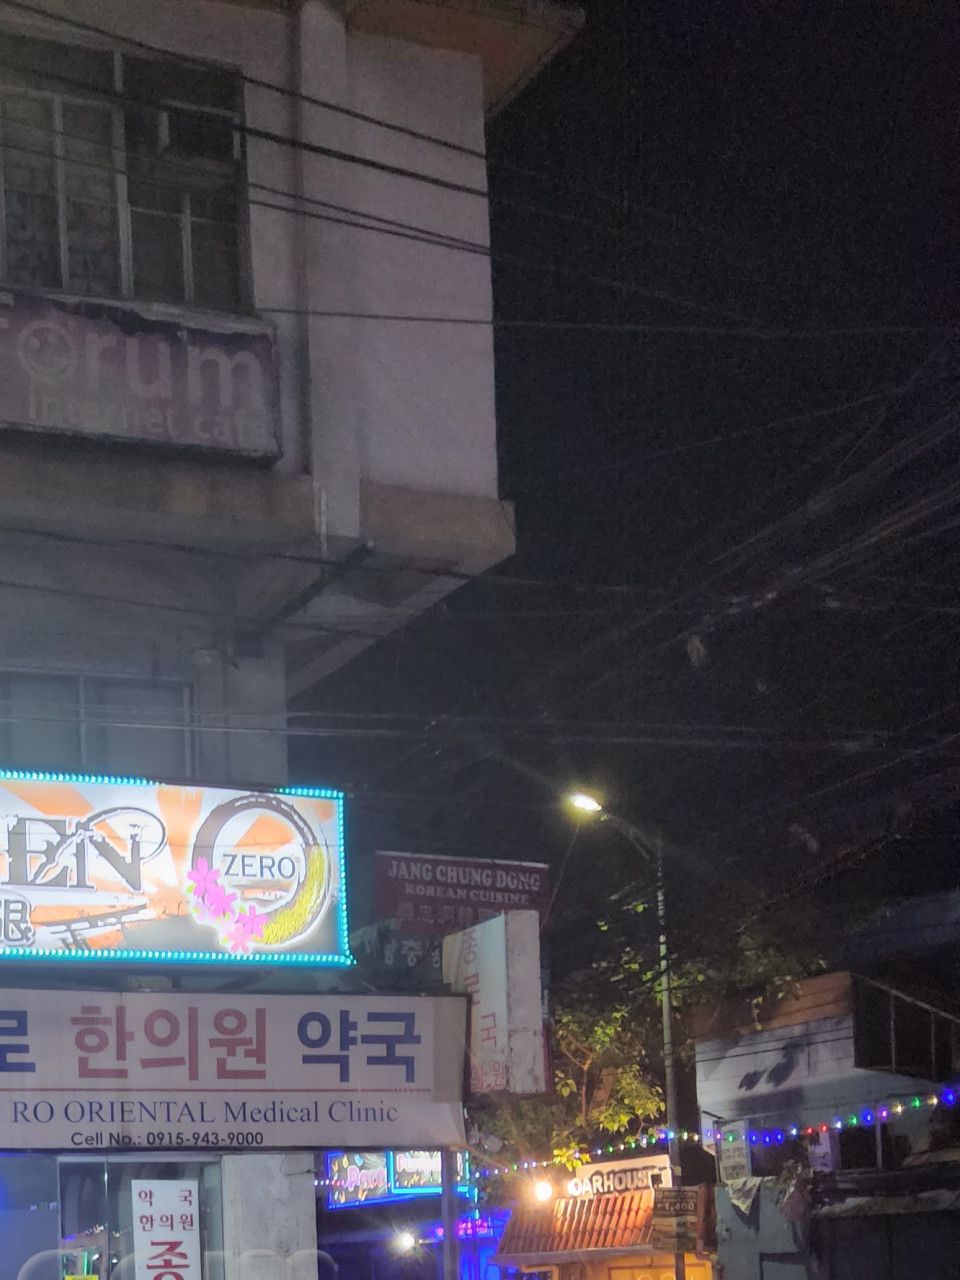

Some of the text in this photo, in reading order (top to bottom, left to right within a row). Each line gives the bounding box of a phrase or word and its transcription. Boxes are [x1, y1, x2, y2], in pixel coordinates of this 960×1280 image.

[222, 852, 298, 880] ZERO
[388, 860, 542, 892] JANG CHUNG DONG
[404, 883, 530, 906] KOREAN CUISINE
[70, 1005, 267, 1082] 한의원
[296, 1008, 423, 1083] 약국
[12, 1100, 56, 1124] RO
[64, 1100, 216, 1124] ORIENTAL
[223, 1100, 320, 1124] Medical
[327, 1101, 399, 1124] Clinic
[70, 1130, 264, 1147] Cell No.: 0915-943-9000
[139, 1213, 195, 1232] 한의원
